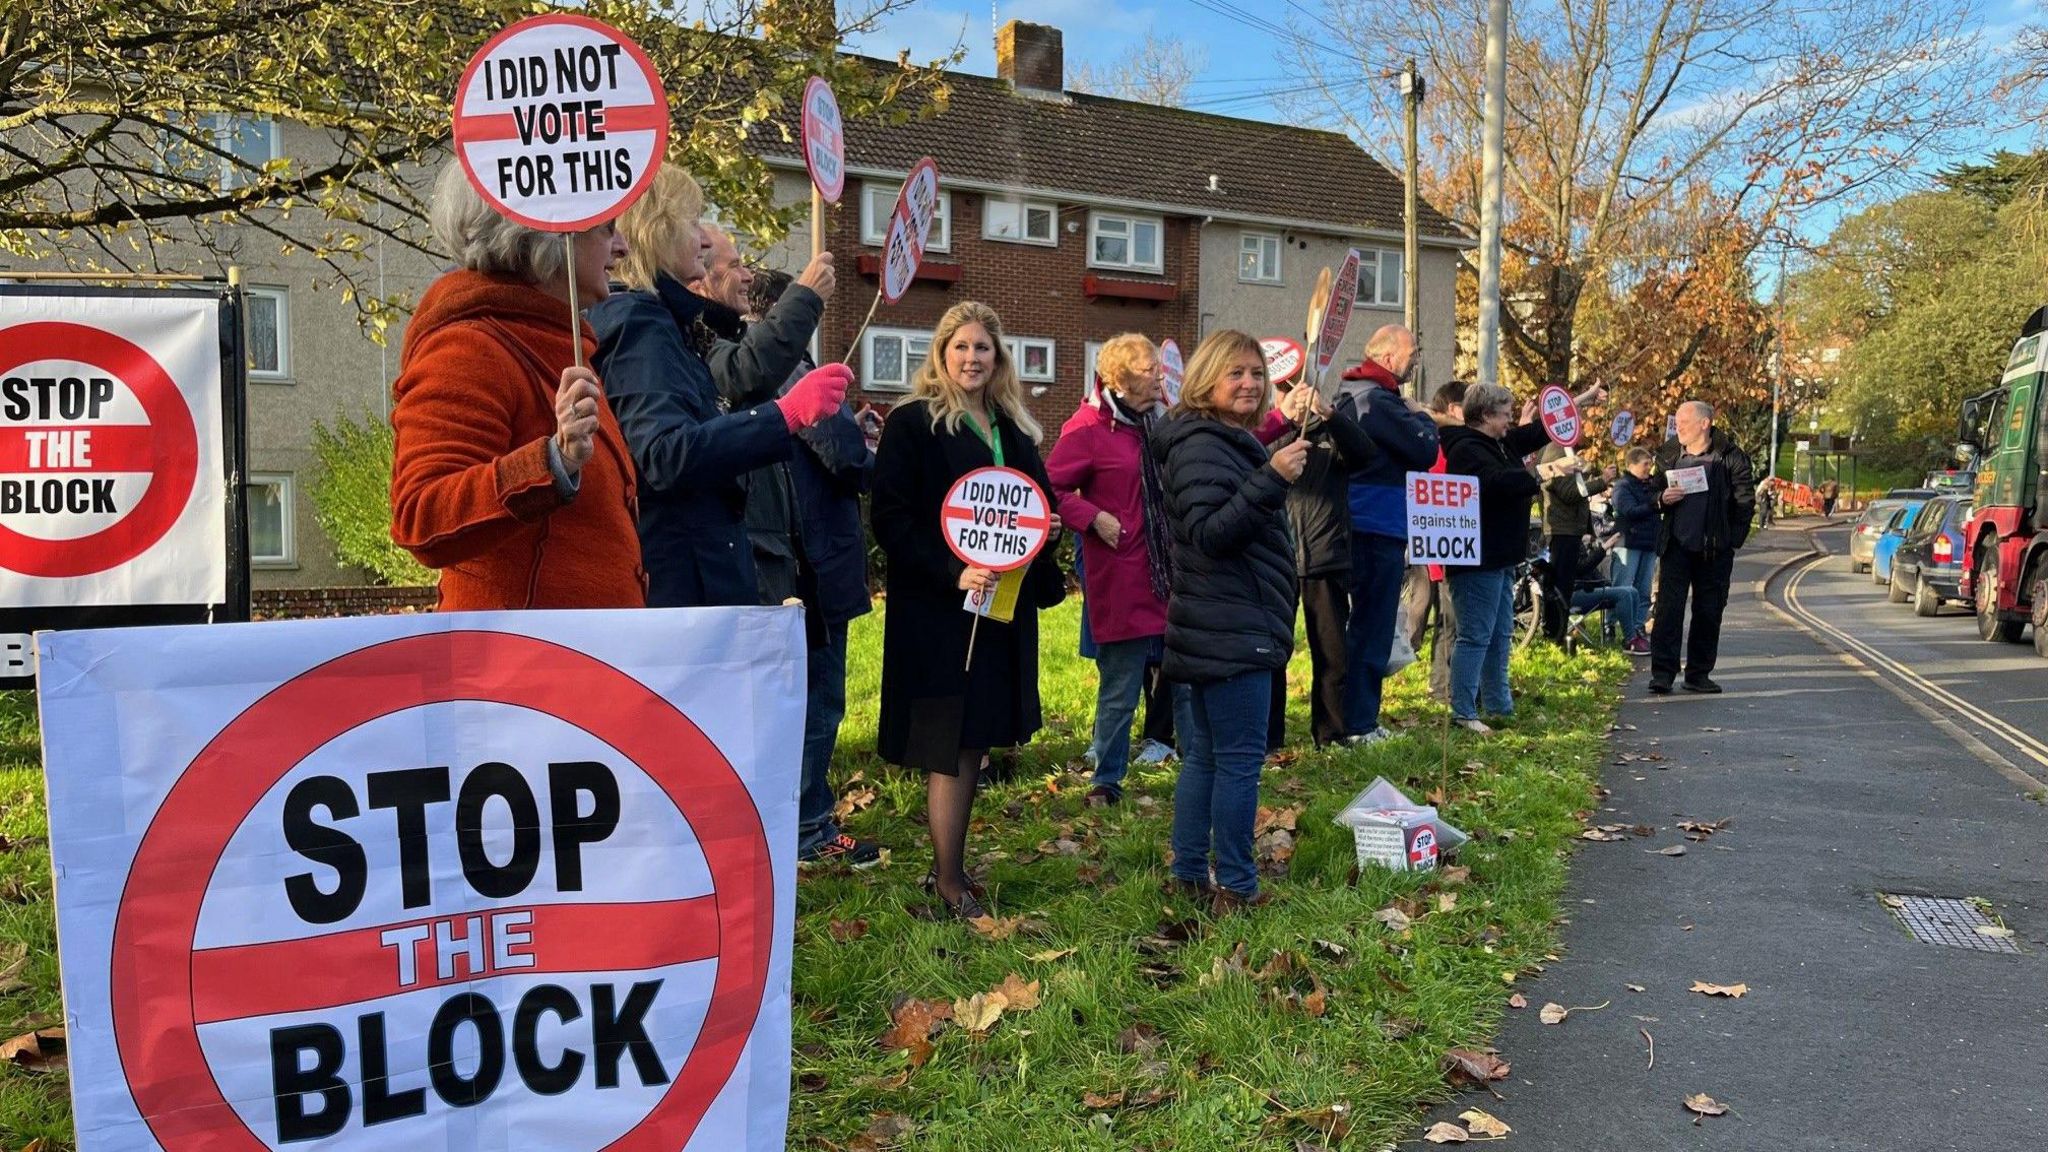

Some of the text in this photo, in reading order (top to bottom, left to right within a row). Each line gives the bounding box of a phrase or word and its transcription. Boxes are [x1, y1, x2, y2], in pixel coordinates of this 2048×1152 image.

[484, 43, 621, 101] I DID NOT
[513, 100, 606, 146] VOTE
[497, 148, 632, 199] FOR THIS
[2, 377, 114, 421] STOP
[1547, 396, 1562, 409] STOP
[1555, 421, 1574, 436] BLOCK
[25, 430, 92, 468] THE
[0, 479, 117, 514] BLOCK
[962, 481, 1032, 508] I DID NOT
[1415, 479, 1472, 507] BEEP
[974, 506, 1018, 530] VOTE
[1412, 513, 1477, 529] against the
[959, 528, 1027, 556] FOR THIS
[1412, 536, 1476, 559] BLOCK
[282, 761, 621, 925] STOP
[1417, 833, 1432, 848] STOP
[380, 910, 536, 987] THE
[269, 977, 671, 1145] BLOCK
